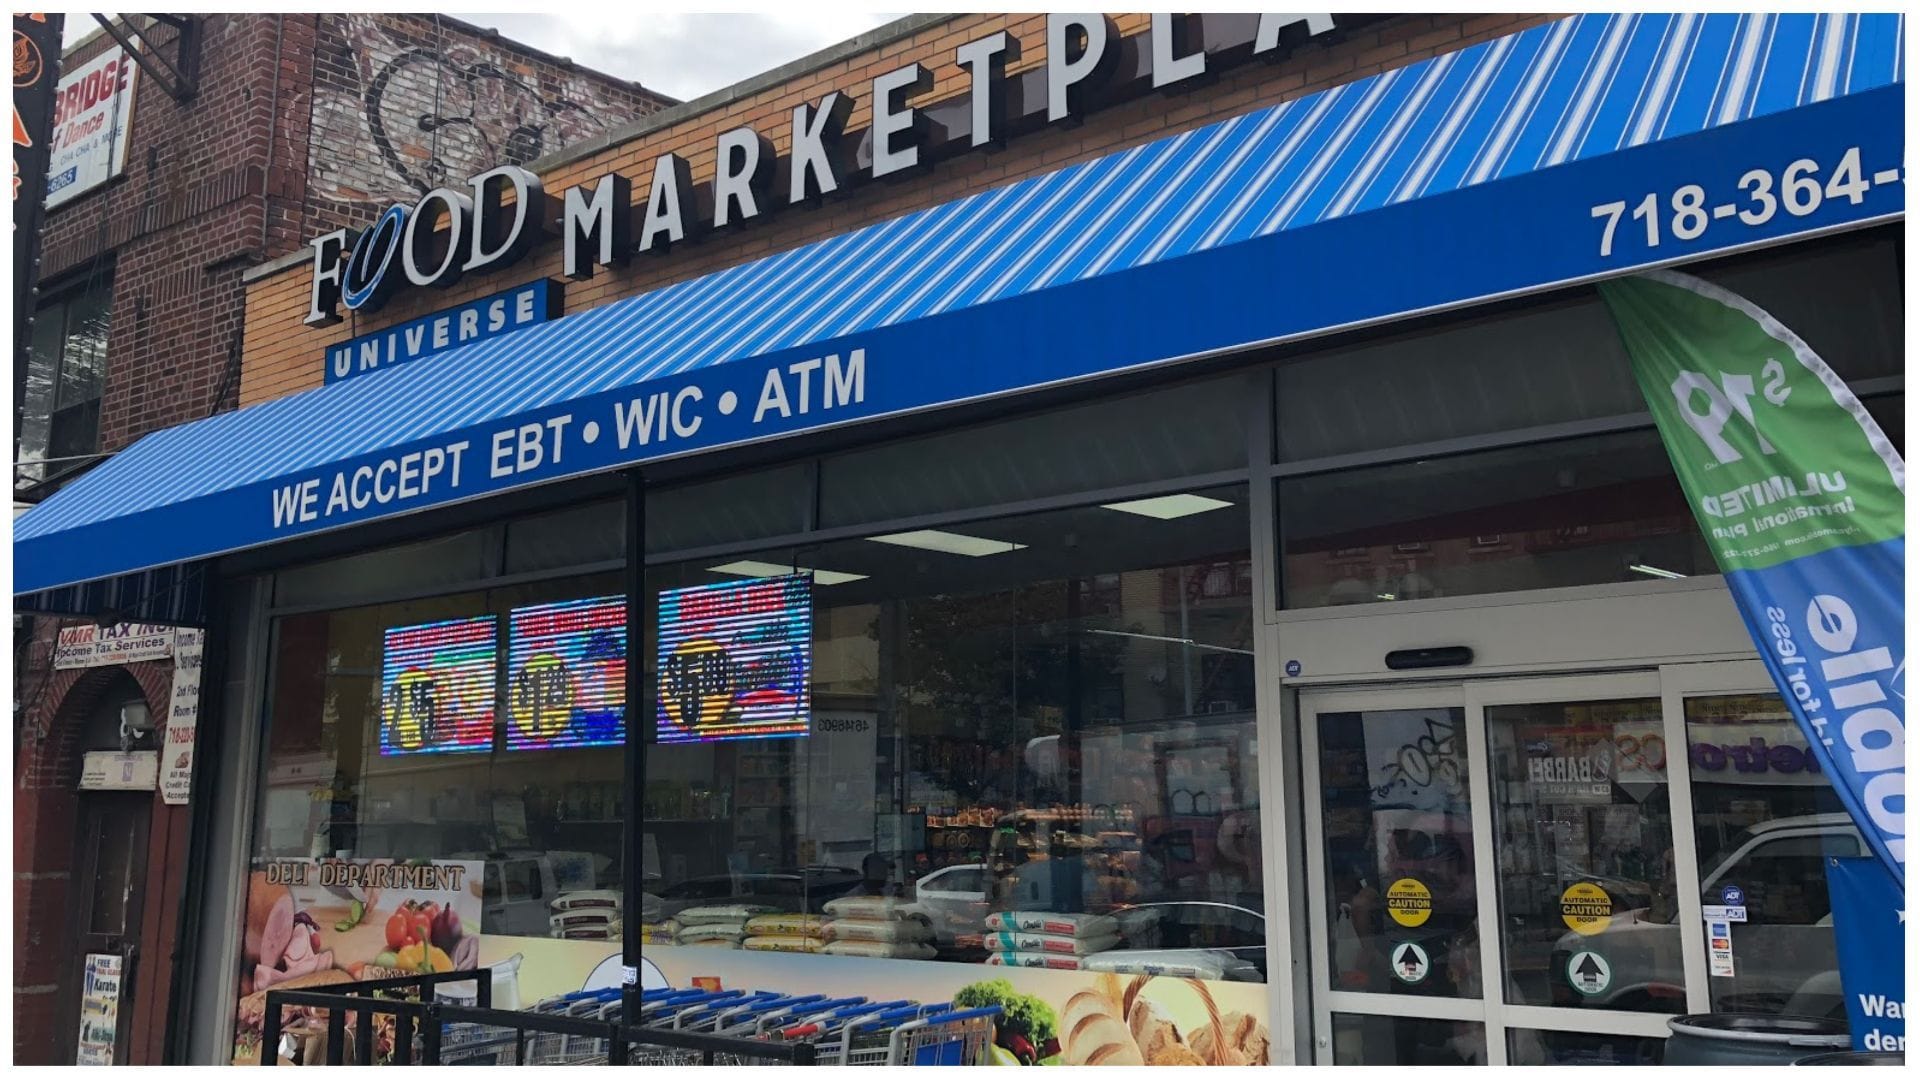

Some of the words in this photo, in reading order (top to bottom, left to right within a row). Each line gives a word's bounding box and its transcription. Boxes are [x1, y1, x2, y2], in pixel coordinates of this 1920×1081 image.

[63, 112, 104, 148] Dance
[1591, 147, 1905, 257] 718-364-
[304, 166, 541, 327] FOOD
[334, 288, 535, 377] UNIVERSE
[272, 478, 320, 528] WE
[325, 441, 469, 516] ACCEPT
[490, 414, 572, 479] EBT
[614, 385, 703, 450] WIC
[753, 349, 866, 423] ATM
[60, 627, 94, 645] VMR
[100, 623, 131, 640] TAX
[56, 646, 92, 658] Income
[95, 643, 112, 653] Tax
[115, 637, 165, 651] Services
[265, 862, 310, 886] DELI
[320, 863, 465, 891] DEPARTMENT
[1388, 898, 1431, 908] CAUTION
[1725, 891, 1740, 900] ADT
[1562, 905, 1611, 915] CAUTION
[94, 979, 117, 993] Karate
